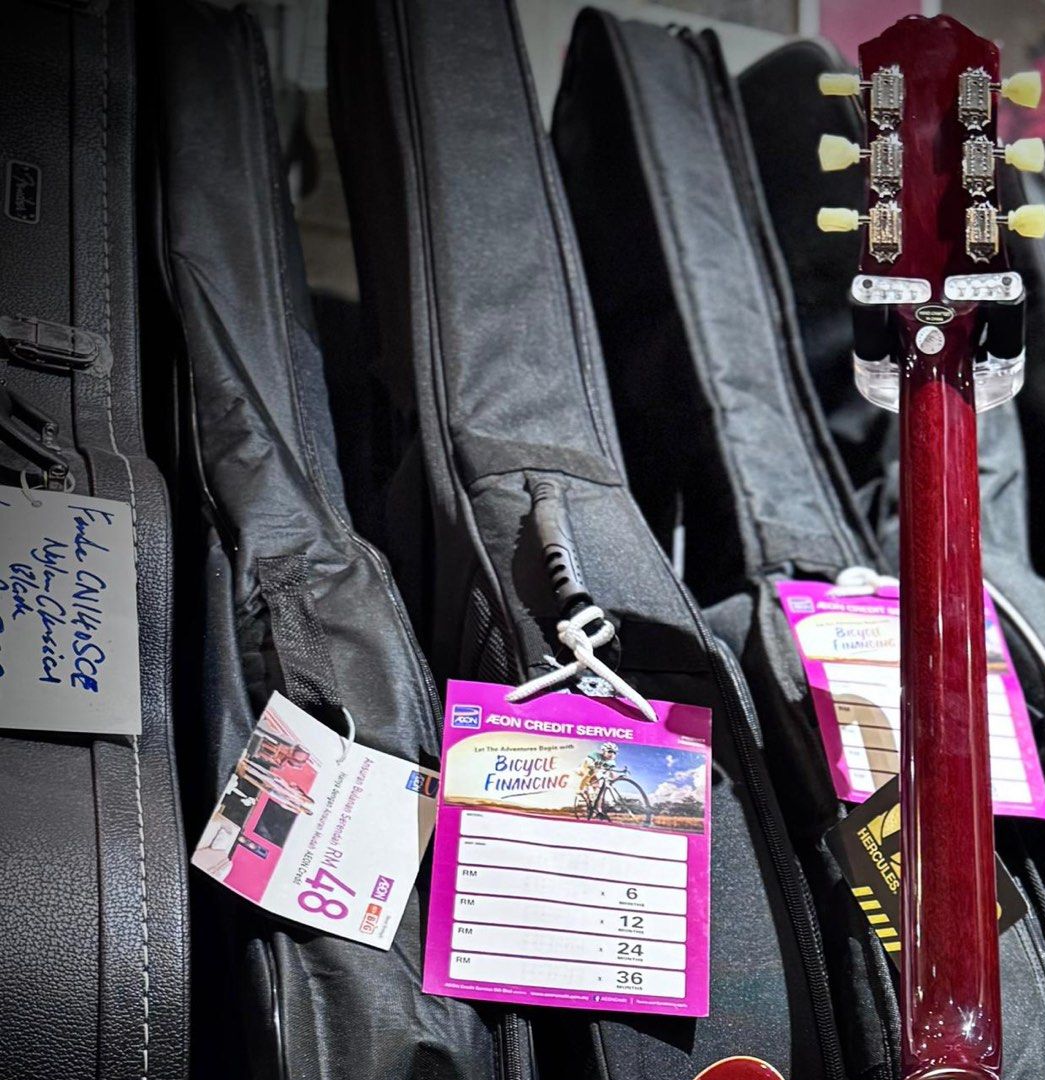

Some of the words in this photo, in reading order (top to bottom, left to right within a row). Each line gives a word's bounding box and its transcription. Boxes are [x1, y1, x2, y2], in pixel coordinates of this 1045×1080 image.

[524, 719, 574, 735] CREDIT
[576, 724, 634, 740] SERVICE
[484, 773, 570, 791] FINANCING
[321, 847, 343, 869] RM
[462, 869, 478, 877] RM
[298, 867, 356, 920] 48
[626, 887, 638, 900] 6
[460, 898, 475, 906] RM
[620, 915, 644, 929] 12
[458, 927, 473, 935] RM
[617, 942, 644, 956] 24
[456, 956, 471, 964] RM
[616, 970, 643, 985] 36
